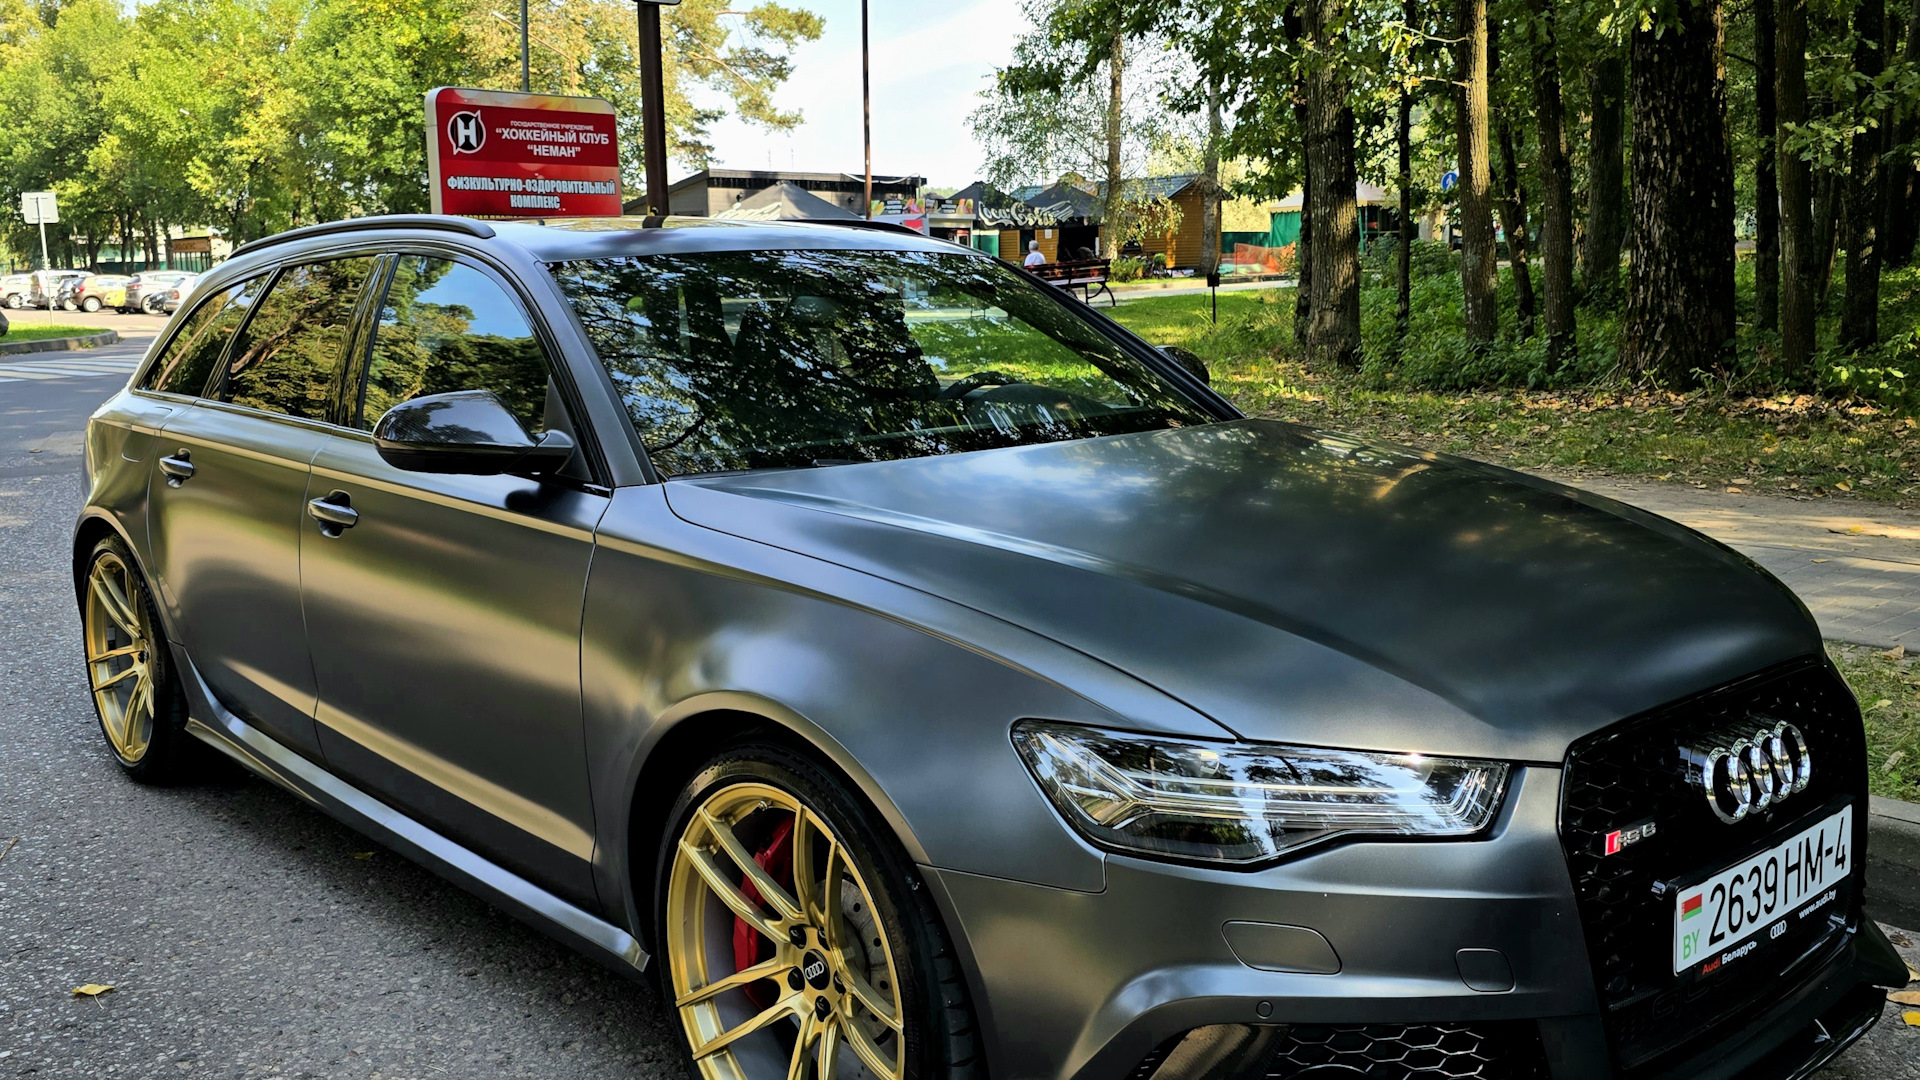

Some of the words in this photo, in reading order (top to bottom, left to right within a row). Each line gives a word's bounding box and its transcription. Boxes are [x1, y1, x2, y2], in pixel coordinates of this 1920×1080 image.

[510, 120, 560, 129] ГОСУДАРСТВЕННОЕ
[579, 132, 609, 145] КЛУБ
[447, 175, 616, 195] ФИЗКУЛЬТУРНО-ОЗДОРОВИТЕЛЬНЫЙ
[510, 194, 561, 209] КОМПЛЕКС
[1799, 889, 1837, 919] www.audi.by
[1683, 929, 1701, 960] BY
[1702, 958, 1721, 975] Audi
[1721, 940, 1757, 965] Беларусь
